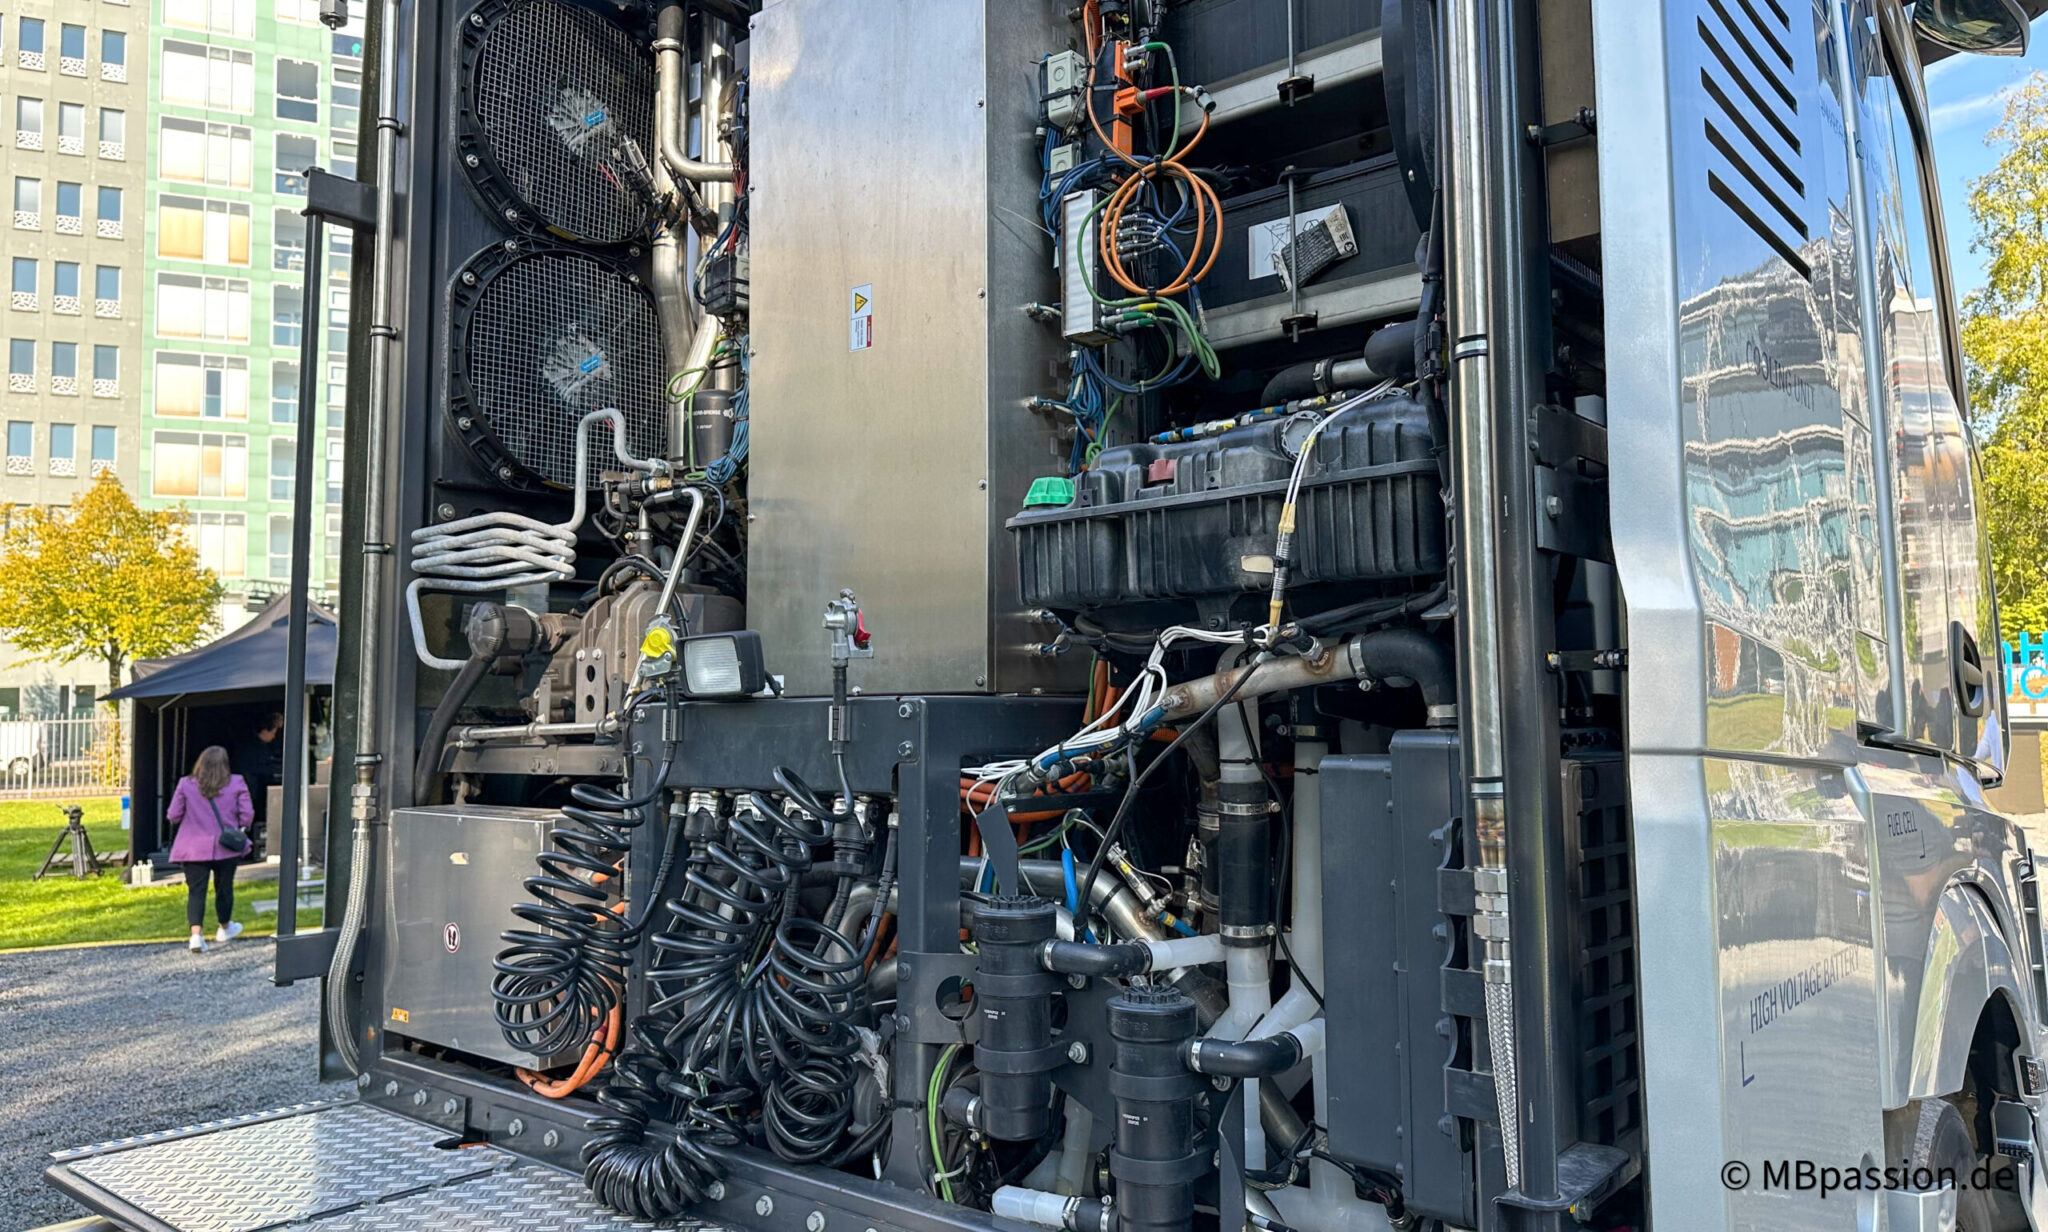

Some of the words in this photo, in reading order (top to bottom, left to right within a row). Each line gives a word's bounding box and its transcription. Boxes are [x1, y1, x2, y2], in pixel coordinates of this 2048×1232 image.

[1746, 340, 1792, 397] COOLING
[1794, 374, 1815, 412] UNIT
[1887, 812, 1903, 838] FUEL
[1903, 810, 1917, 834] CELL
[1749, 986, 1778, 1034] HIGH
[1779, 962, 1822, 1014] VOLTAGE
[1824, 945, 1859, 989] BATTERY
